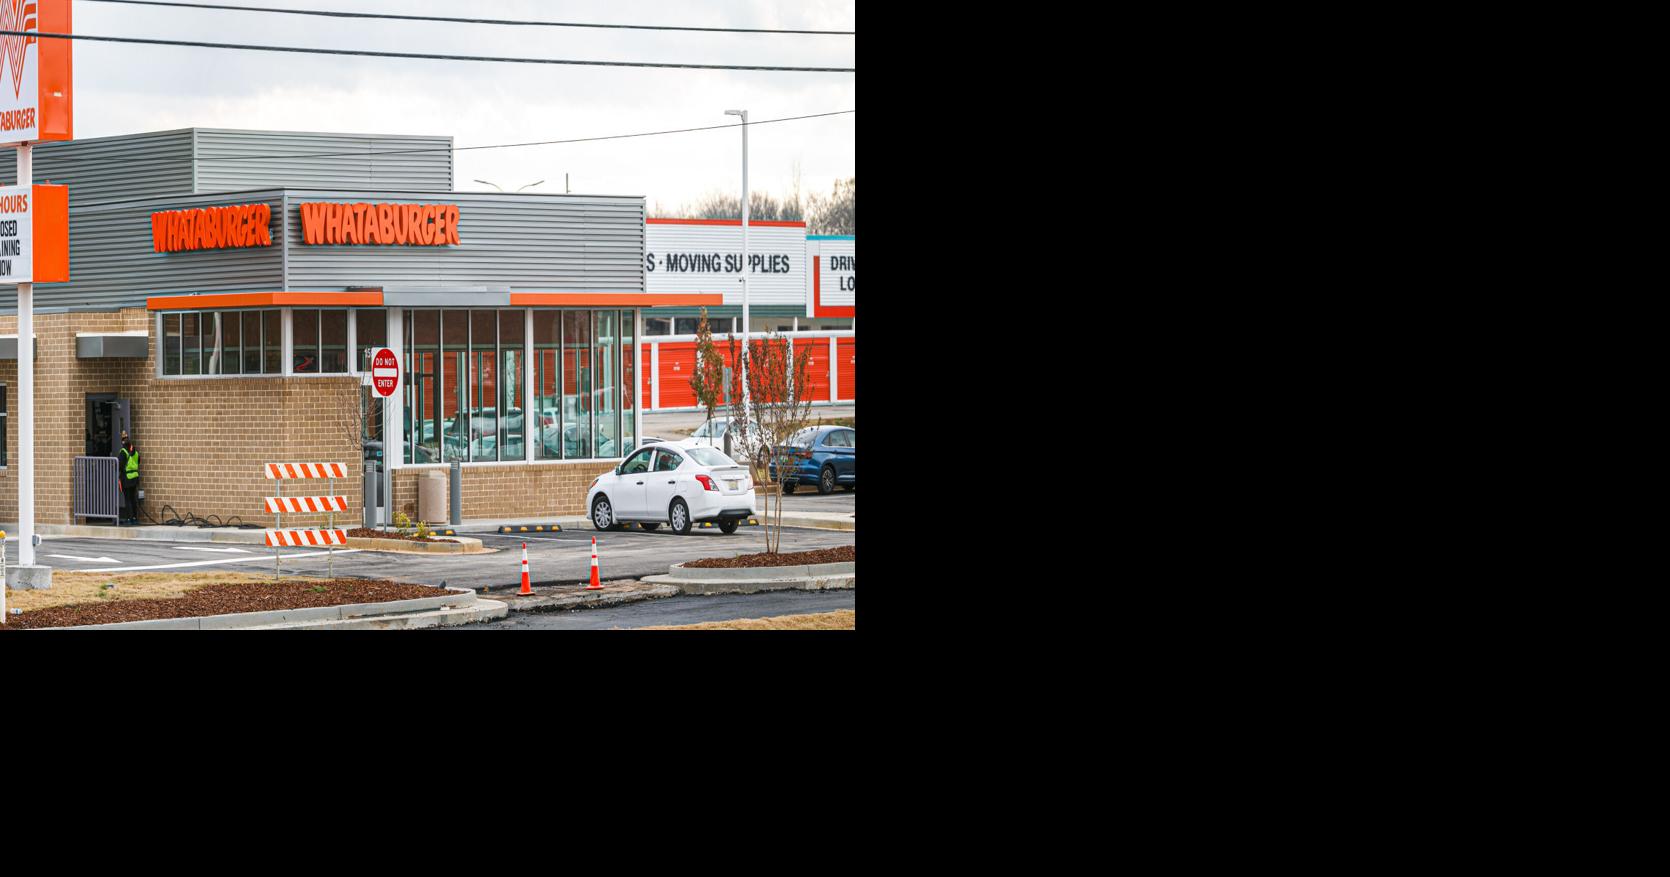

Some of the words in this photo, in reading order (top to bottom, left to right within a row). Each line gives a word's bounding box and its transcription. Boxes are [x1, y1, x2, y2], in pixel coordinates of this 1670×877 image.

[0, 107, 35, 131] ABURGER
[151, 203, 271, 252] WHATABURGER
[300, 202, 461, 246] WHATABURGER
[0, 239, 20, 256] INING
[666, 253, 721, 272] MOVING
[376, 358, 383, 366] DO
[385, 358, 395, 366] NOT
[378, 380, 393, 388] ENTER
